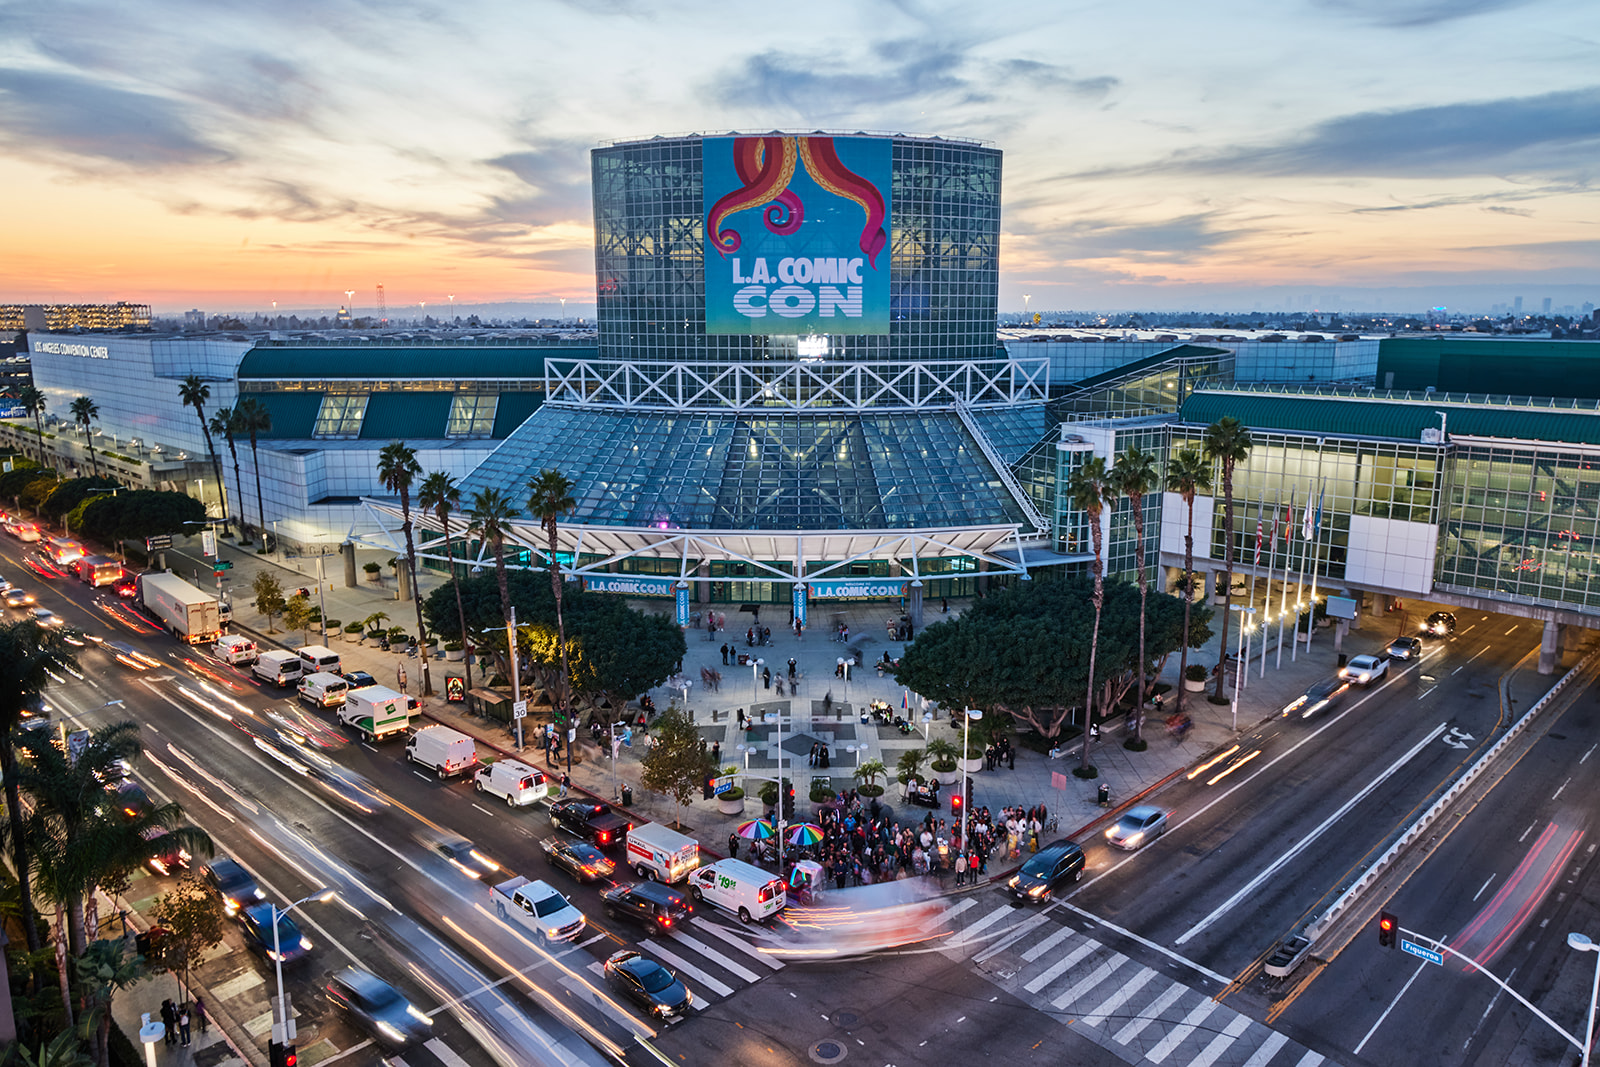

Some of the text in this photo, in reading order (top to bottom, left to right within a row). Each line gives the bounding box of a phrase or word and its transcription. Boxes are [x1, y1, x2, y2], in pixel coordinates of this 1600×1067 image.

[778, 257, 863, 284] COMIC
[733, 285, 863, 318] CON
[34, 341, 109, 359] LOS ANGELES CONVENTION CENTER
[639, 583, 667, 595] CON
[869, 585, 898, 597] CON
[515, 709, 526, 718] 30
[1405, 943, 1439, 962] Figueroa
